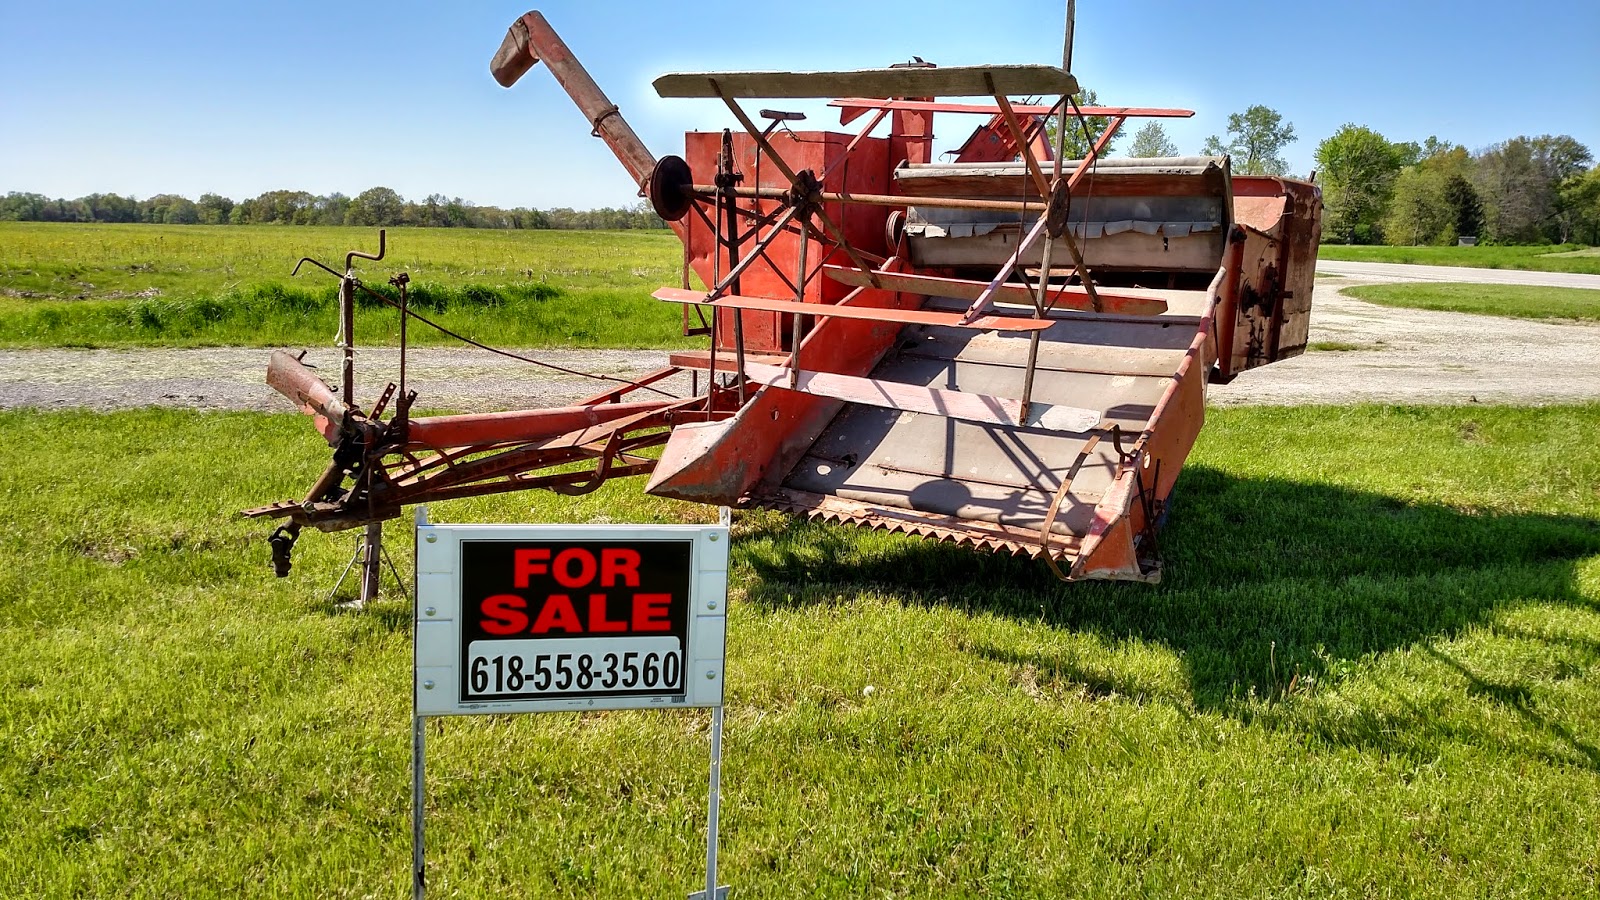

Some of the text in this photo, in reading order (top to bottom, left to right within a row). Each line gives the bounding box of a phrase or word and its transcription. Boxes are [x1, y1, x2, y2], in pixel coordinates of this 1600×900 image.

[514, 548, 641, 588] FOR
[480, 593, 672, 635] SALE
[470, 651, 680, 693] 618-558-3560
